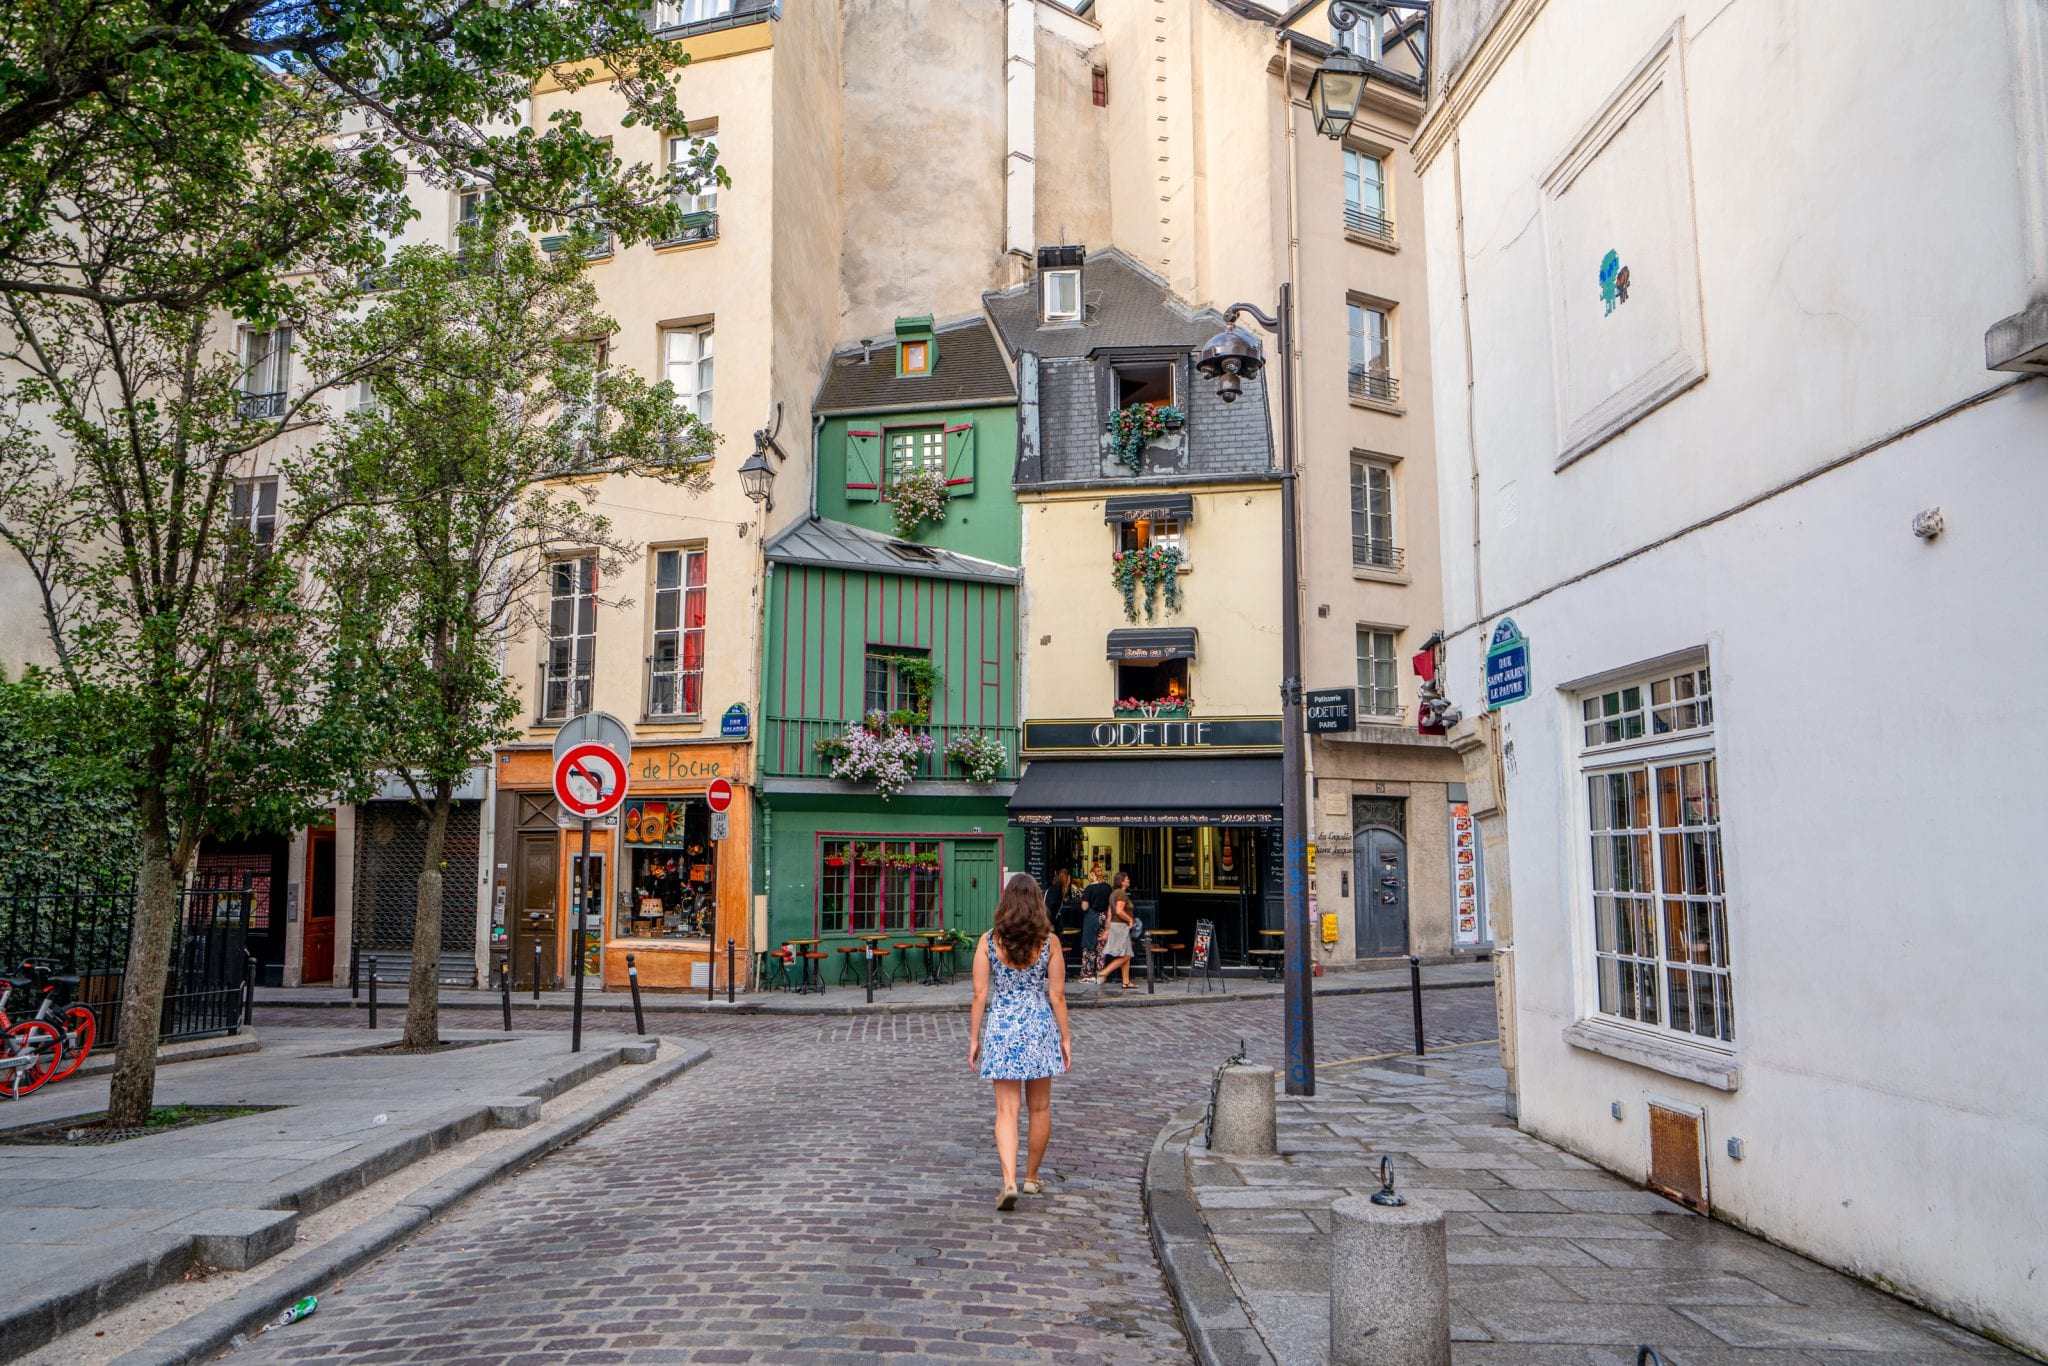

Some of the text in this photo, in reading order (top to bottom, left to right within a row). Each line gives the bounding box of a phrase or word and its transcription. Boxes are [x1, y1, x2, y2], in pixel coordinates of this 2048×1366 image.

[1124, 508, 1170, 521] ODETTE
[1124, 648, 1148, 658] Salle
[1498, 655, 1512, 669] RUE
[1487, 665, 1526, 686] SAINT JULIEN
[1490, 681, 1523, 699] LE PAUVRE
[1308, 704, 1348, 719] ODETTE
[1318, 721, 1338, 729] PARIS
[1091, 721, 1212, 748] ODETTE
[642, 757, 661, 780] de
[1221, 814, 1246, 823] SALON
